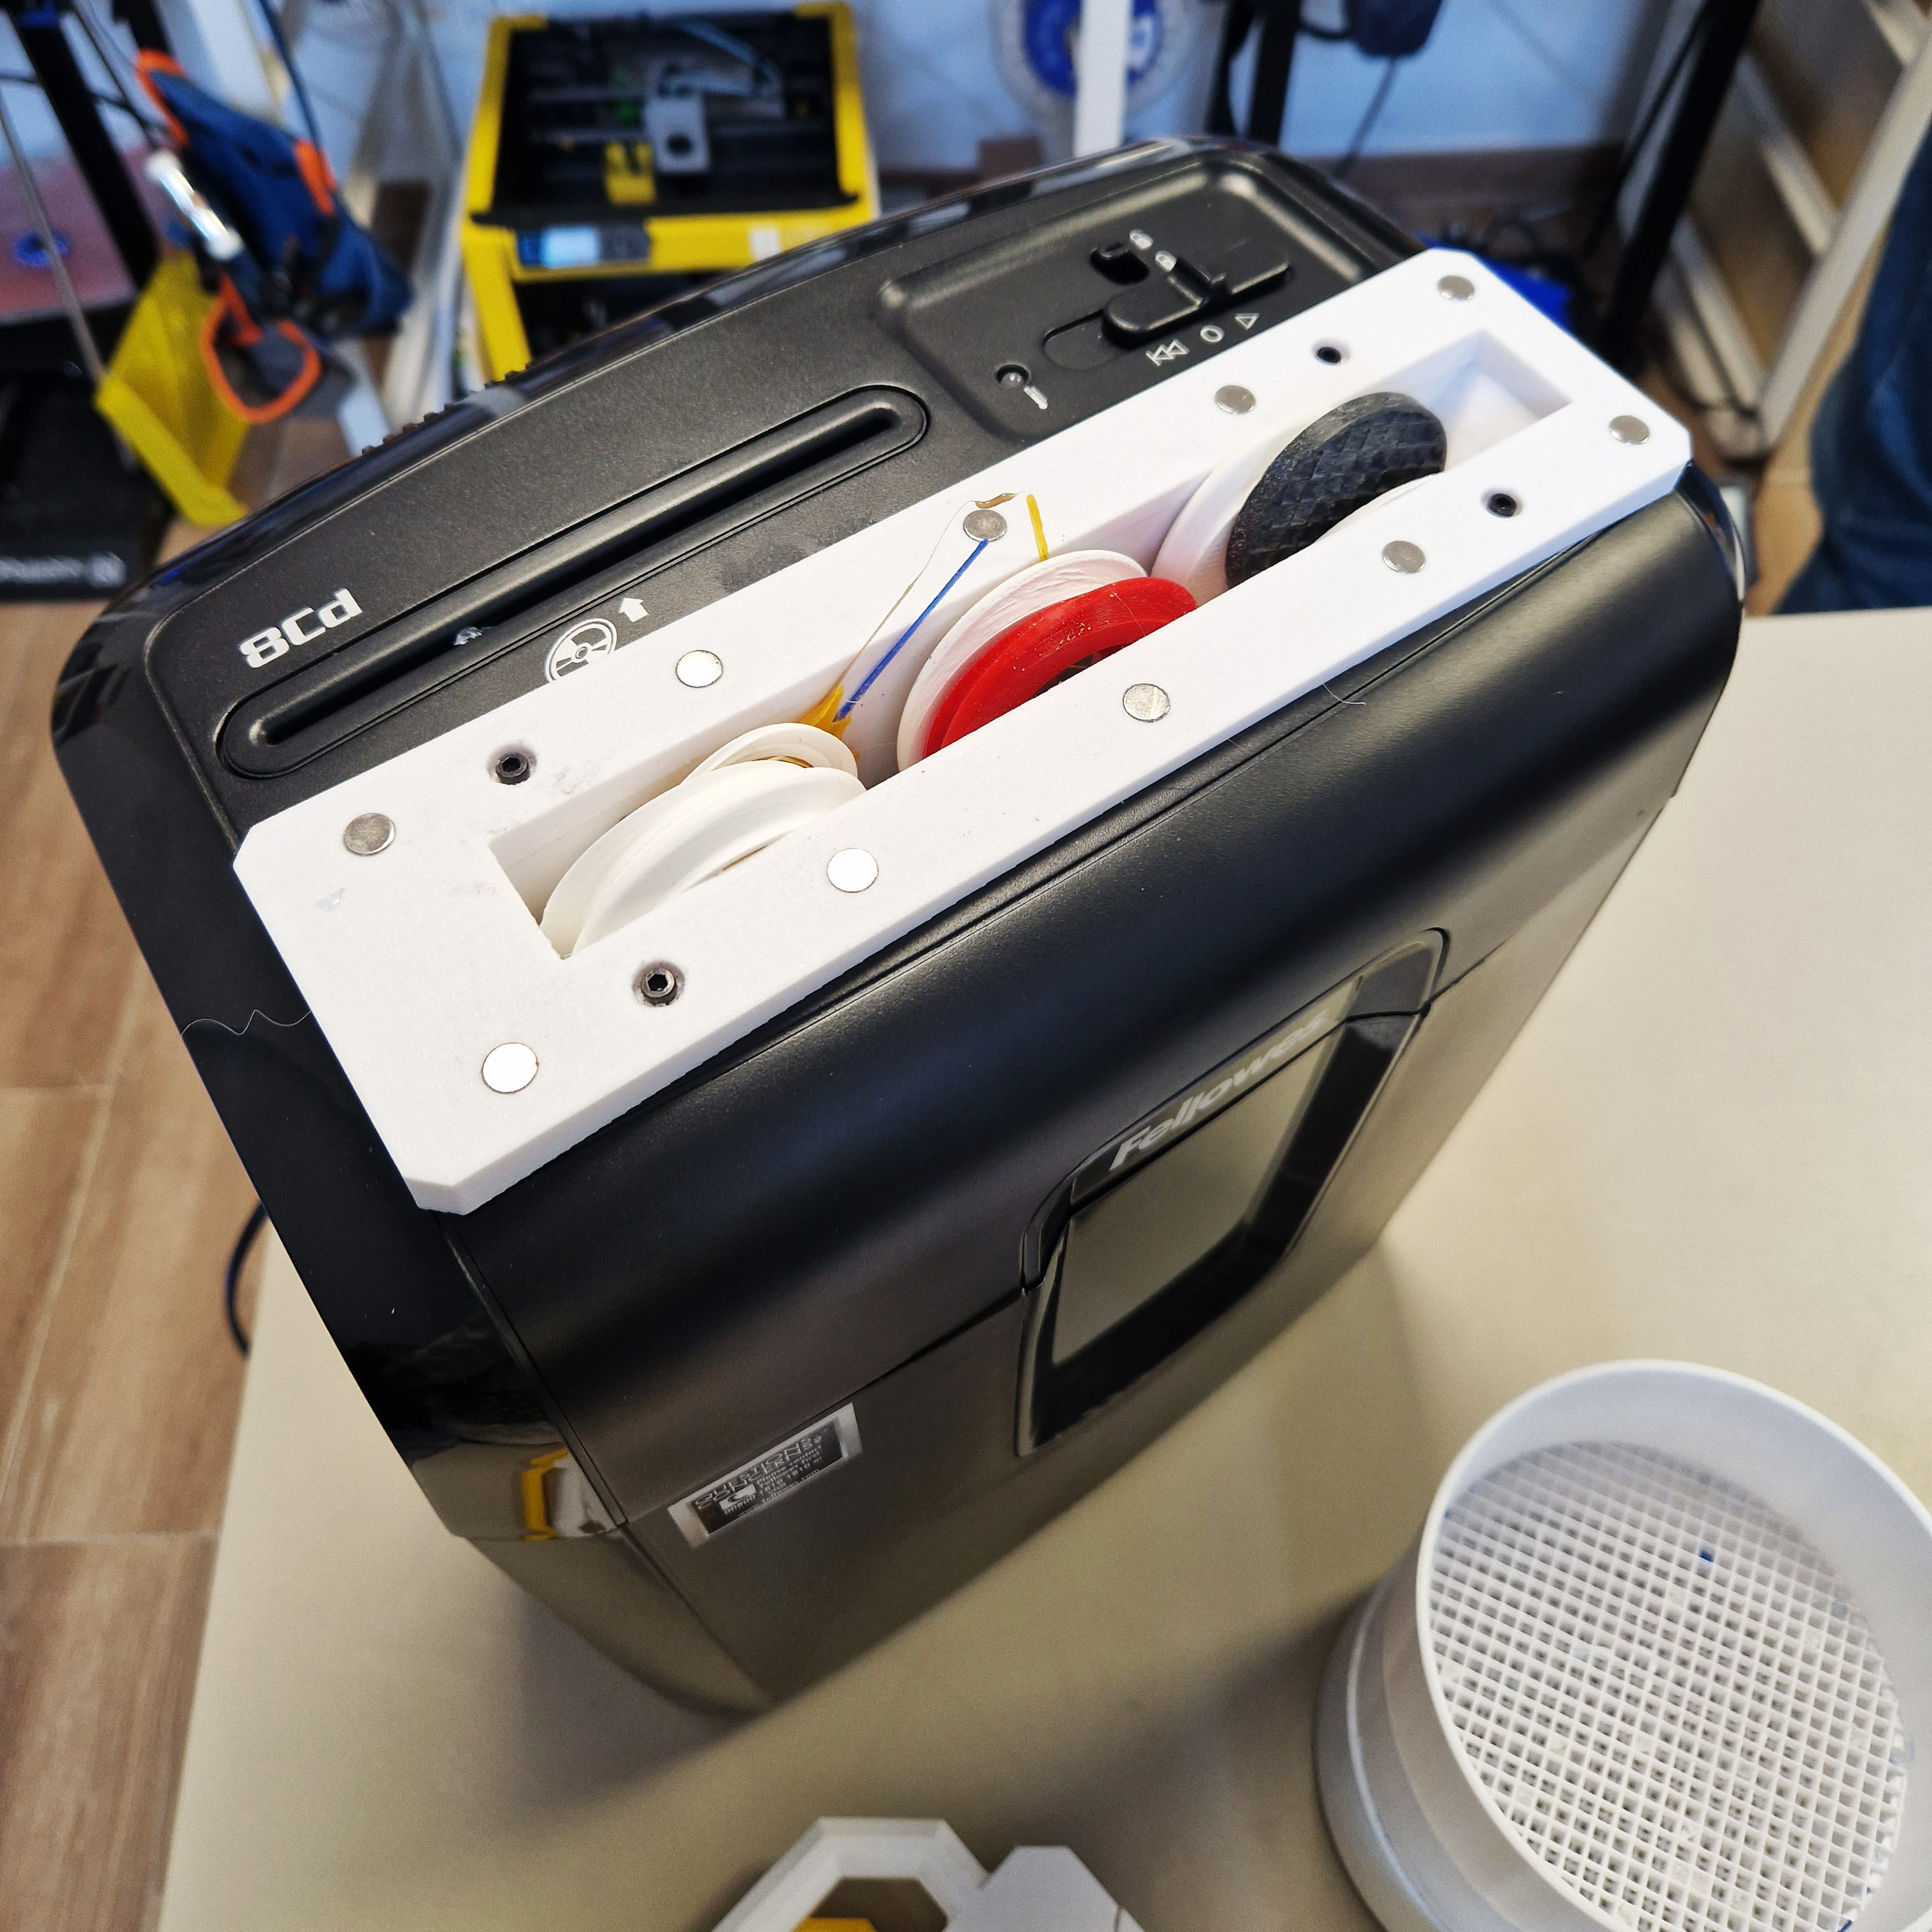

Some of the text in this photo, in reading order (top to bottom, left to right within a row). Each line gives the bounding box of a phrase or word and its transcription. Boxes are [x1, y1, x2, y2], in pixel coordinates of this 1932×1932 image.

[240, 588, 363, 668] 8Cd
[1110, 1010, 1326, 1171] Fellowes
[694, 1435, 812, 1506] QUESTIONS
